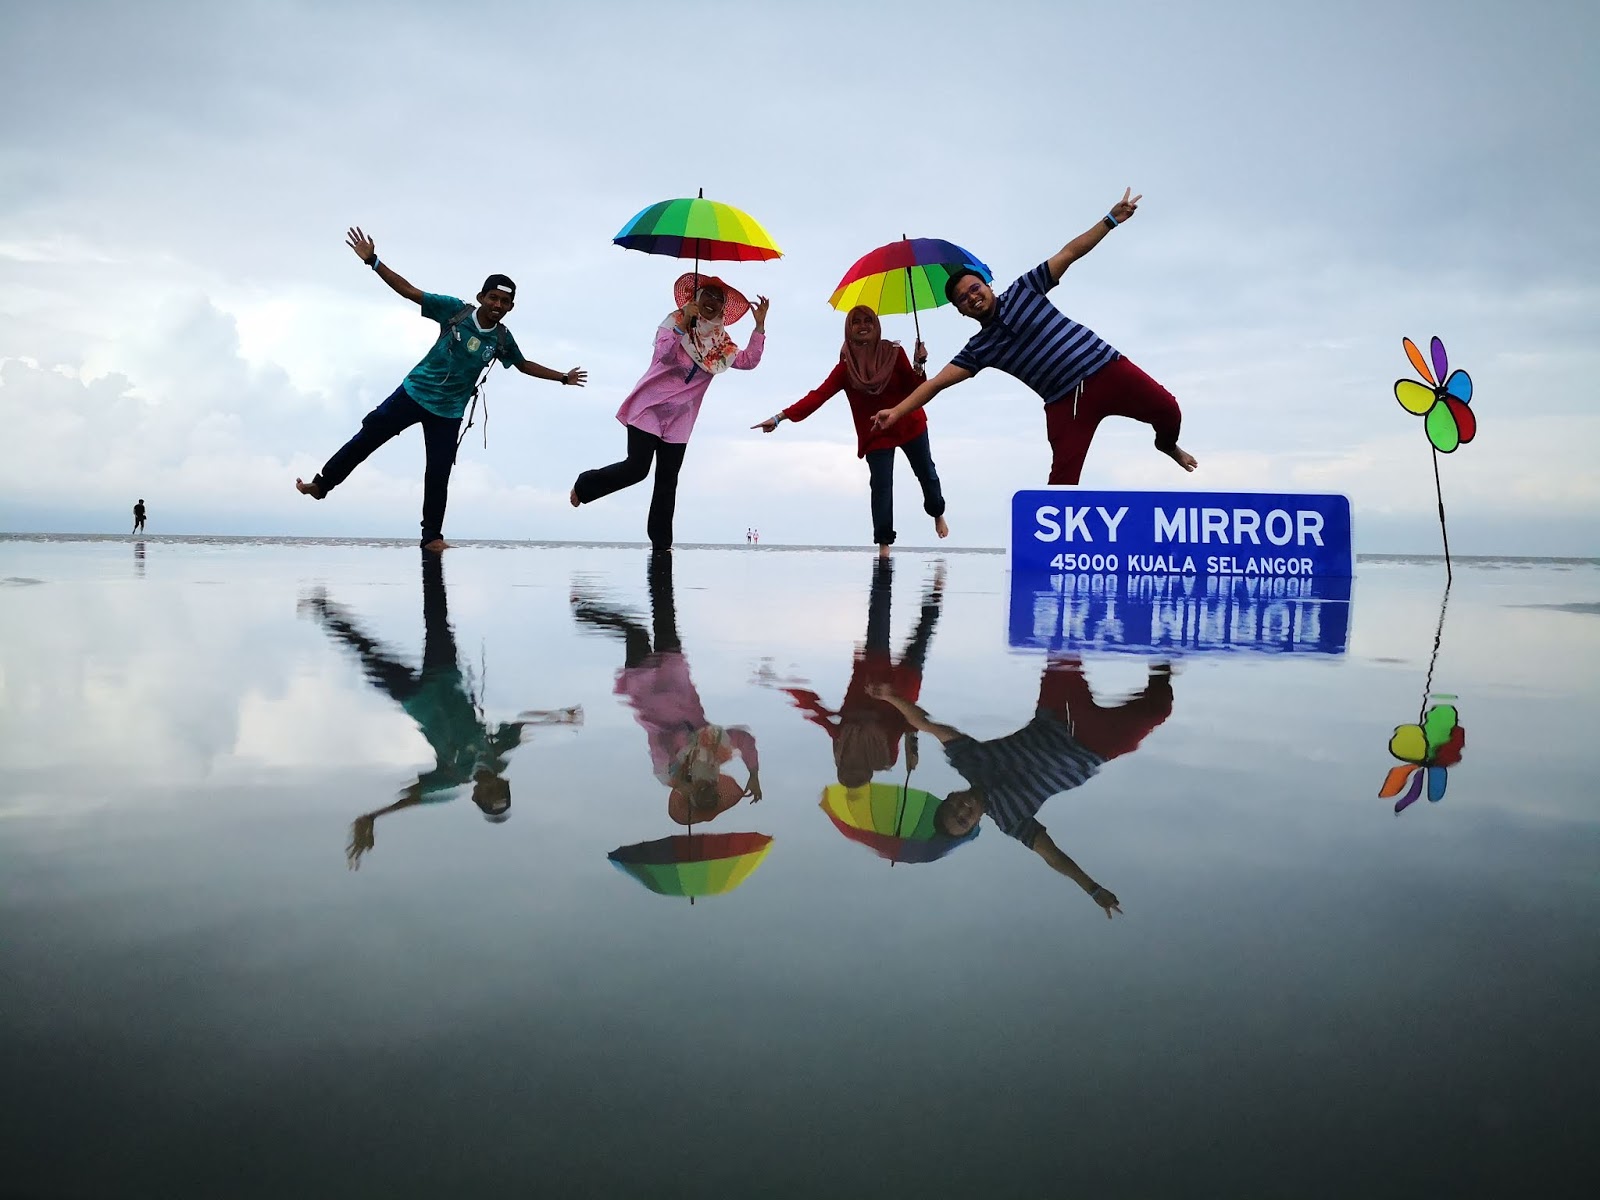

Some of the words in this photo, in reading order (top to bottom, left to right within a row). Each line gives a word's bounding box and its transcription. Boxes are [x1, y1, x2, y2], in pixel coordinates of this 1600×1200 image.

[1034, 506, 1129, 543] SKY
[1154, 507, 1325, 547] MIRROR
[1050, 553, 1119, 571] 45000
[1127, 555, 1197, 573] KUALA
[1206, 556, 1314, 575] SELANGOR
